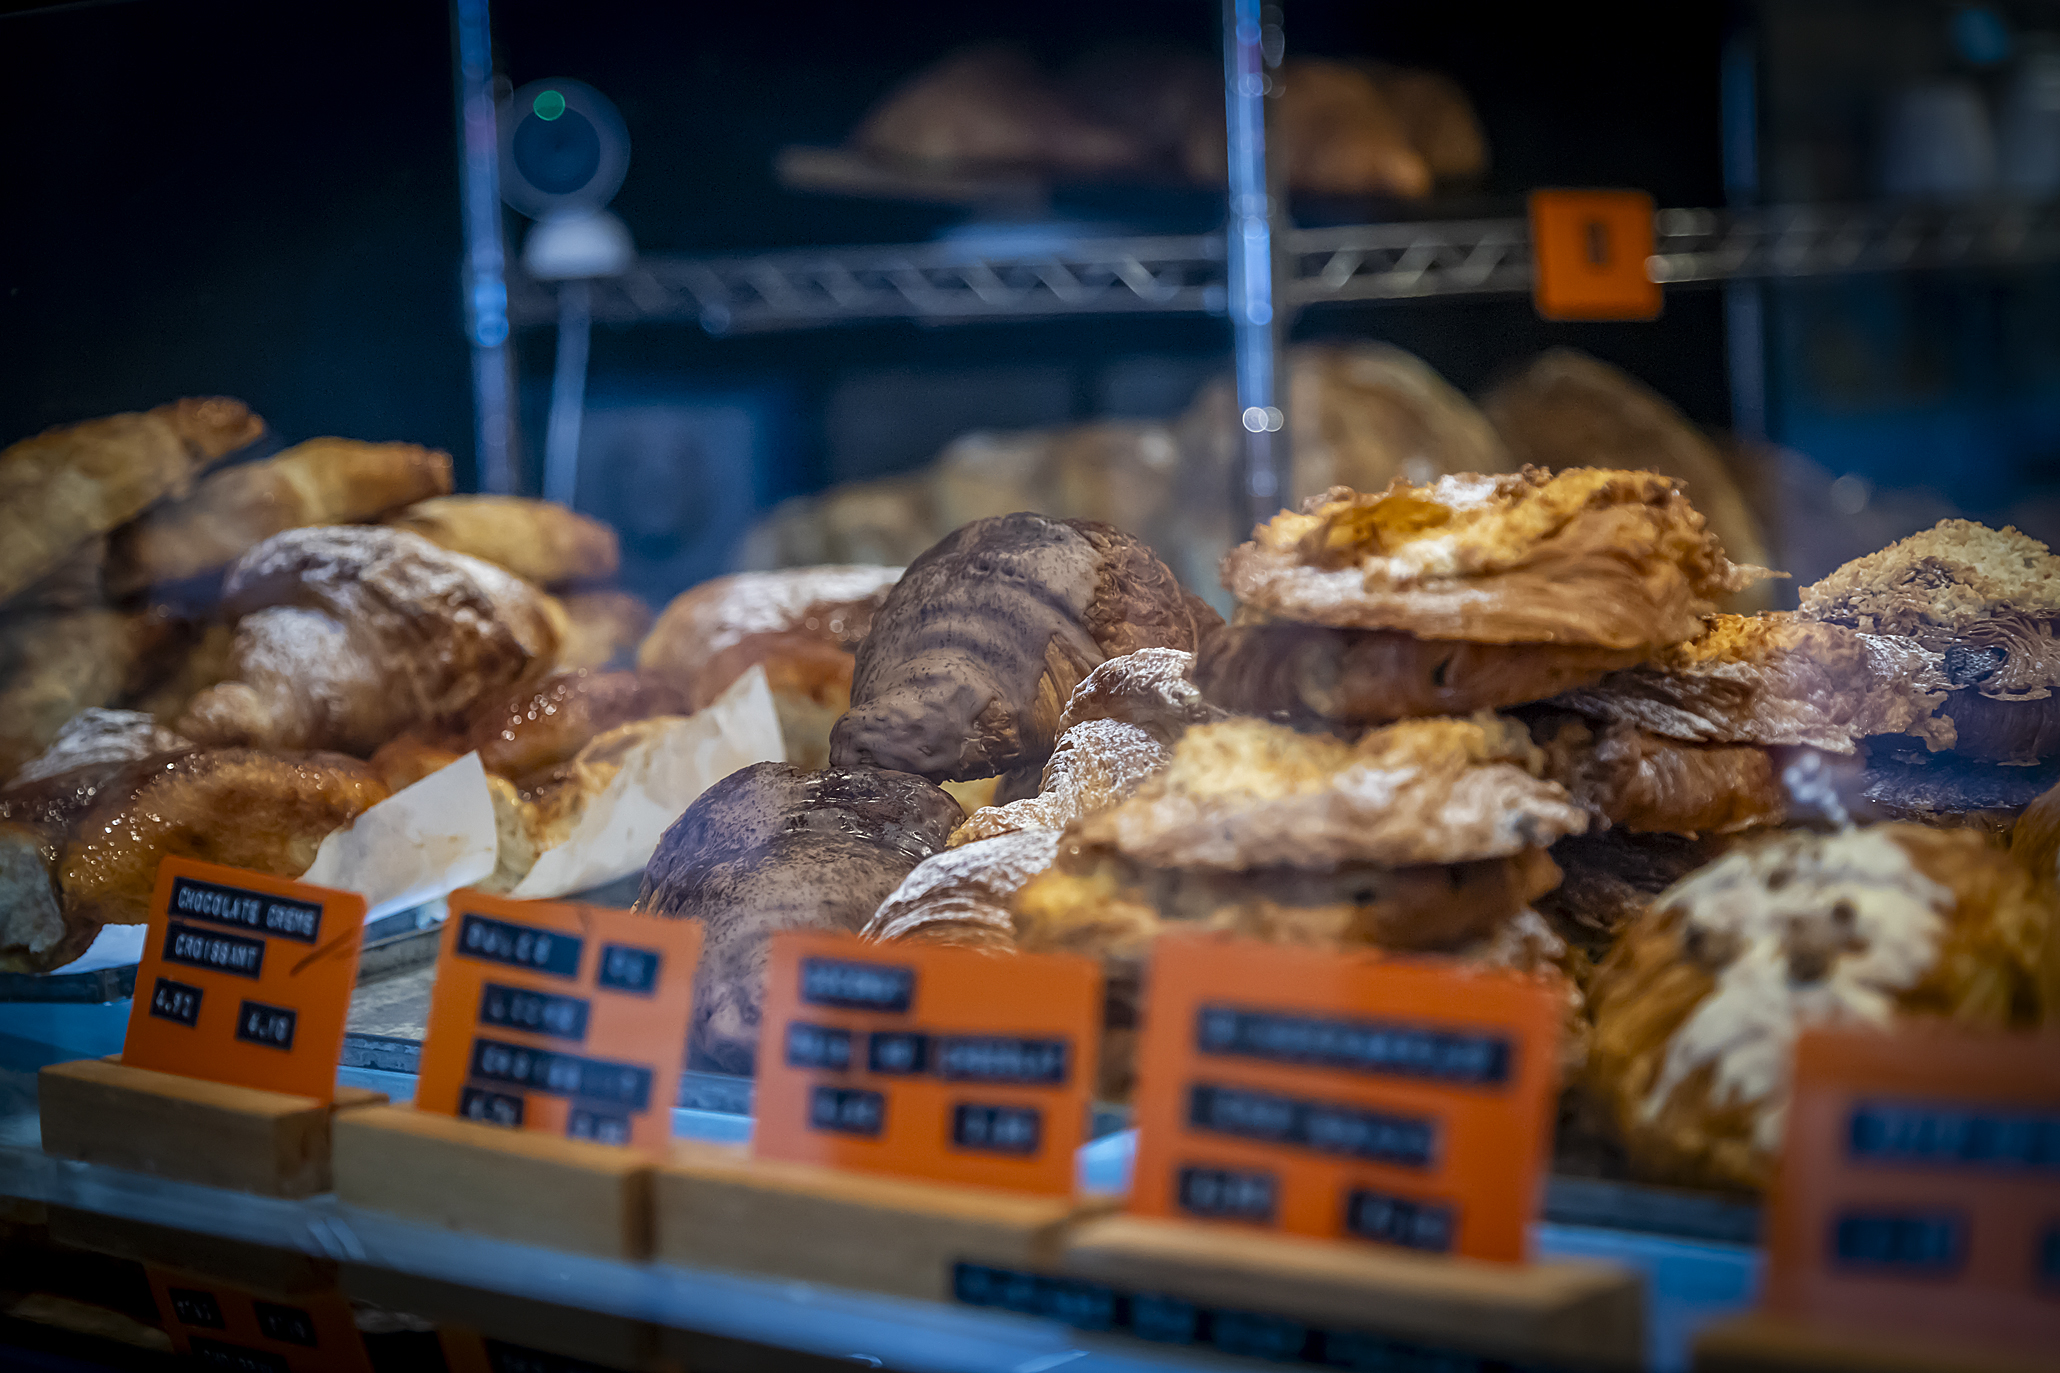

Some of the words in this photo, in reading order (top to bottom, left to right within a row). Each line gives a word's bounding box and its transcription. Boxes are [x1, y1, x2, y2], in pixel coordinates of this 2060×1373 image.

[177, 886, 261, 925] CHOCOLATE
[266, 903, 316, 936] CREME
[174, 932, 258, 969] CROISSANT
